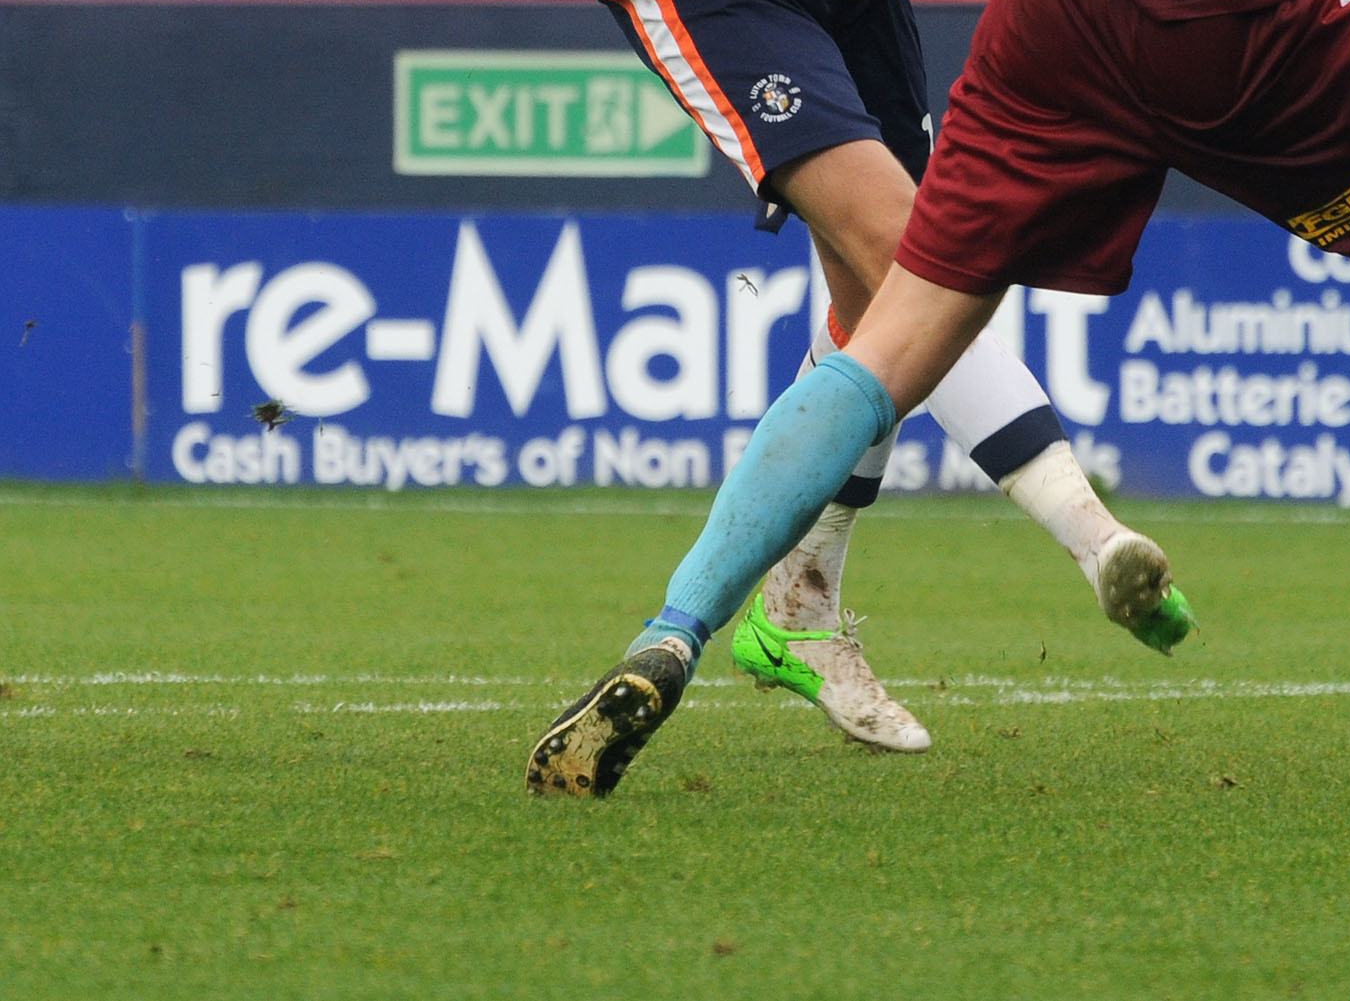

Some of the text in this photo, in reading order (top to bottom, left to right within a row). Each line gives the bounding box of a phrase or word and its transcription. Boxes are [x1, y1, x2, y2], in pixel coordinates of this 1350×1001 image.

[417, 84, 583, 153] EXIT
[172, 420, 300, 484] Cash
[312, 424, 508, 492] Buyer's
[517, 424, 585, 487] of
[594, 426, 711, 487] Non
